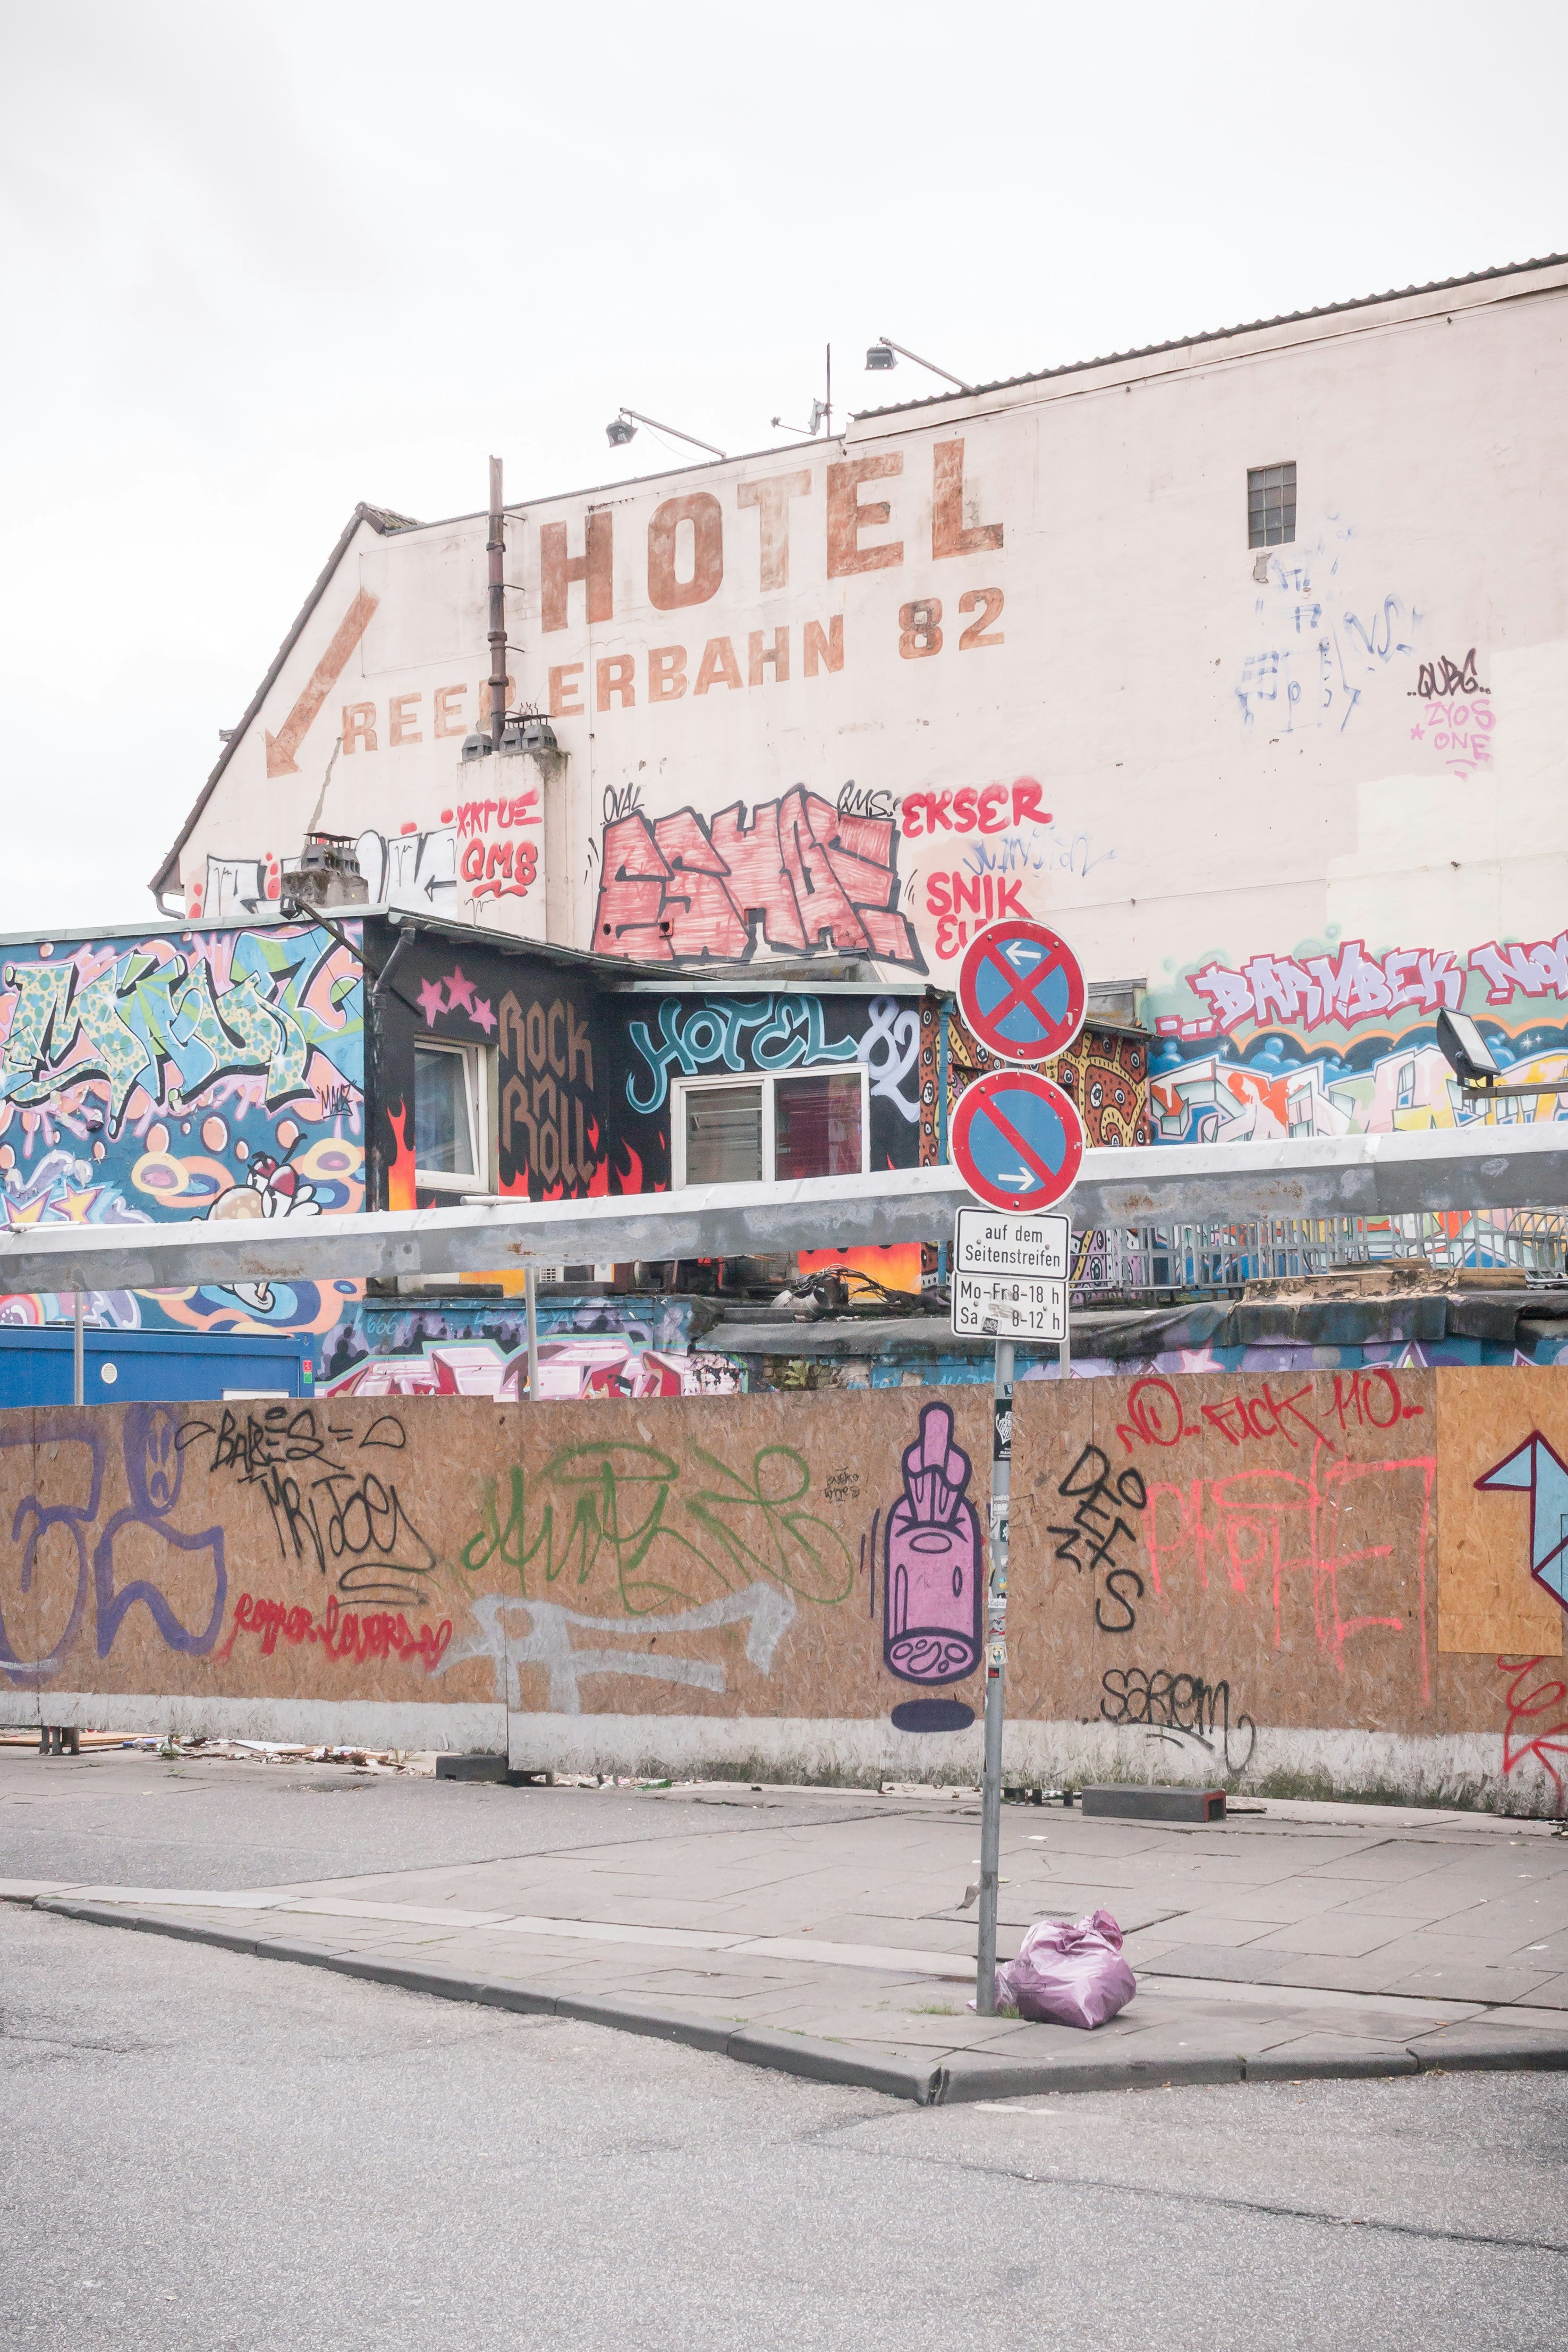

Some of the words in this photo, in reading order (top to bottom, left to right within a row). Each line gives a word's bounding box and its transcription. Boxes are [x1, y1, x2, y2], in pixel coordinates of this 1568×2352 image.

[540, 437, 1004, 633] HOTEL
[898, 587, 1005, 659] 82
[902, 775, 1053, 838] EKSER
[927, 872, 1033, 919] SNIK
[499, 990, 594, 1092] ROCK
[626, 994, 859, 1113] HOTEL
[858, 995, 920, 1122] 82
[965, 1245, 1060, 1267] Seitenstreifen
[986, 1224, 1007, 1240] auf
[1015, 1225, 1042, 1243] dem
[961, 1281, 1007, 1301] Mo-Fr
[1012, 1284, 1044, 1303] 8-18
[1052, 1287, 1059, 1304] h
[961, 1307, 978, 1324] Sa
[1012, 1310, 1044, 1329] 8-12
[1053, 1313, 1060, 1330] h
[1201, 1384, 1336, 1452] FUCK
